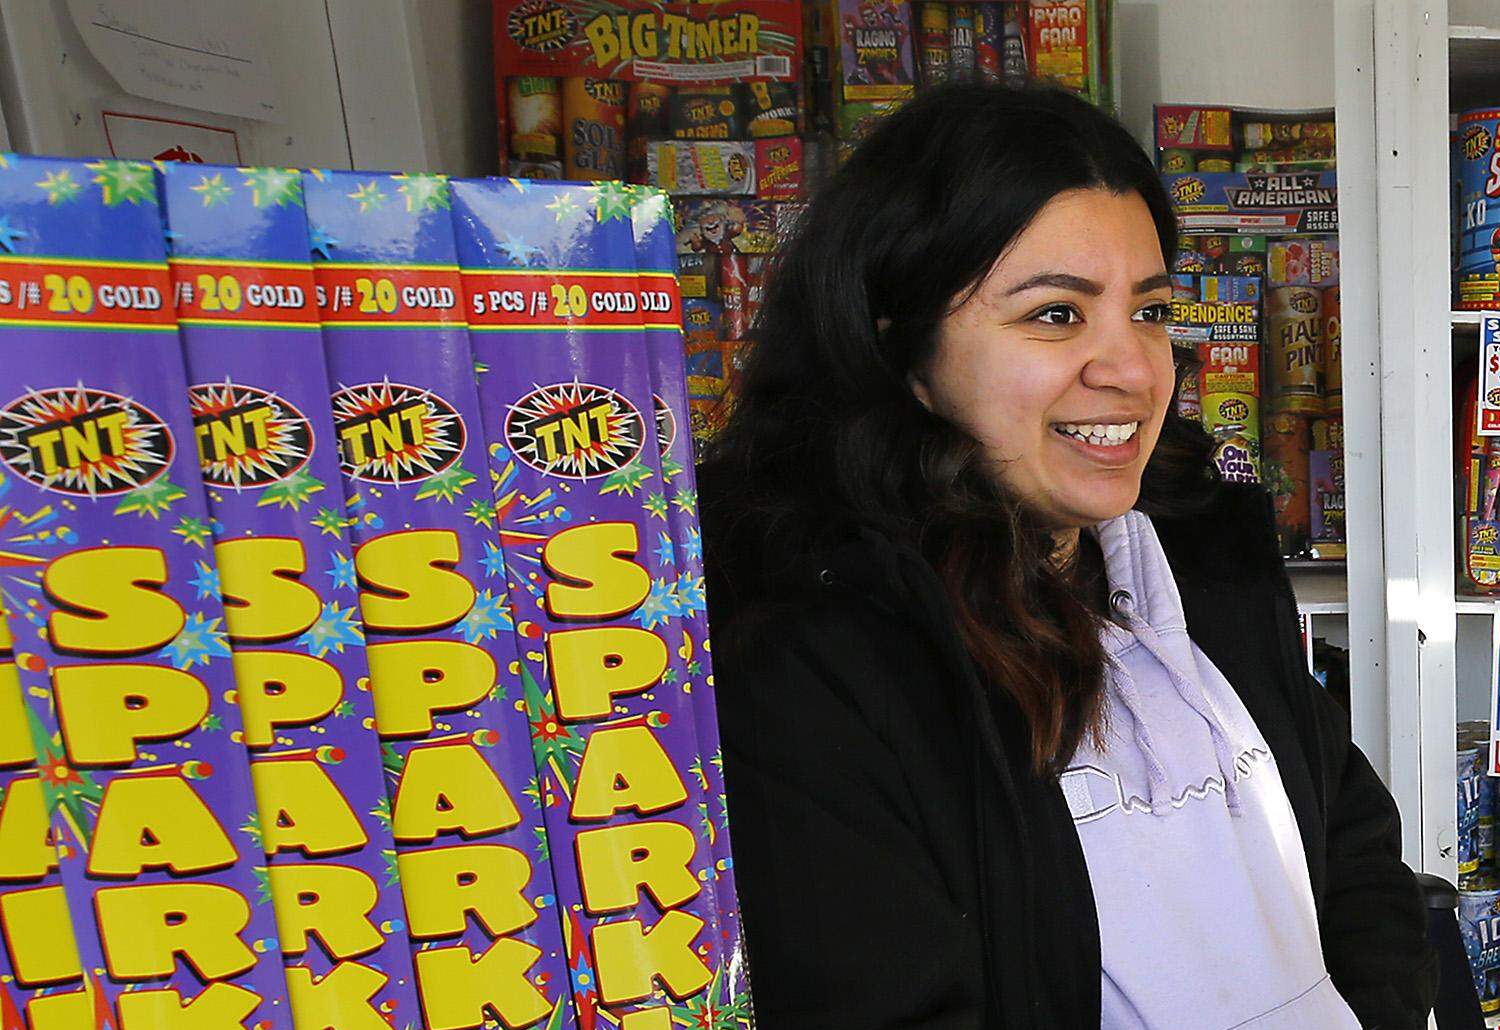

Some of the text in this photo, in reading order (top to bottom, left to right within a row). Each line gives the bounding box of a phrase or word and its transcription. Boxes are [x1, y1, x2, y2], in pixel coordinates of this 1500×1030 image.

[584, 12, 761, 69] BIG TIMER
[1267, 177, 1303, 191] ALL
[1236, 189, 1333, 206] AMERICAN
[247, 285, 305, 309] GOLD
[402, 286, 455, 309] GOLD
[591, 291, 637, 313] GOLD
[342, 402, 437, 468] TNT
[536, 404, 616, 467] TNT
